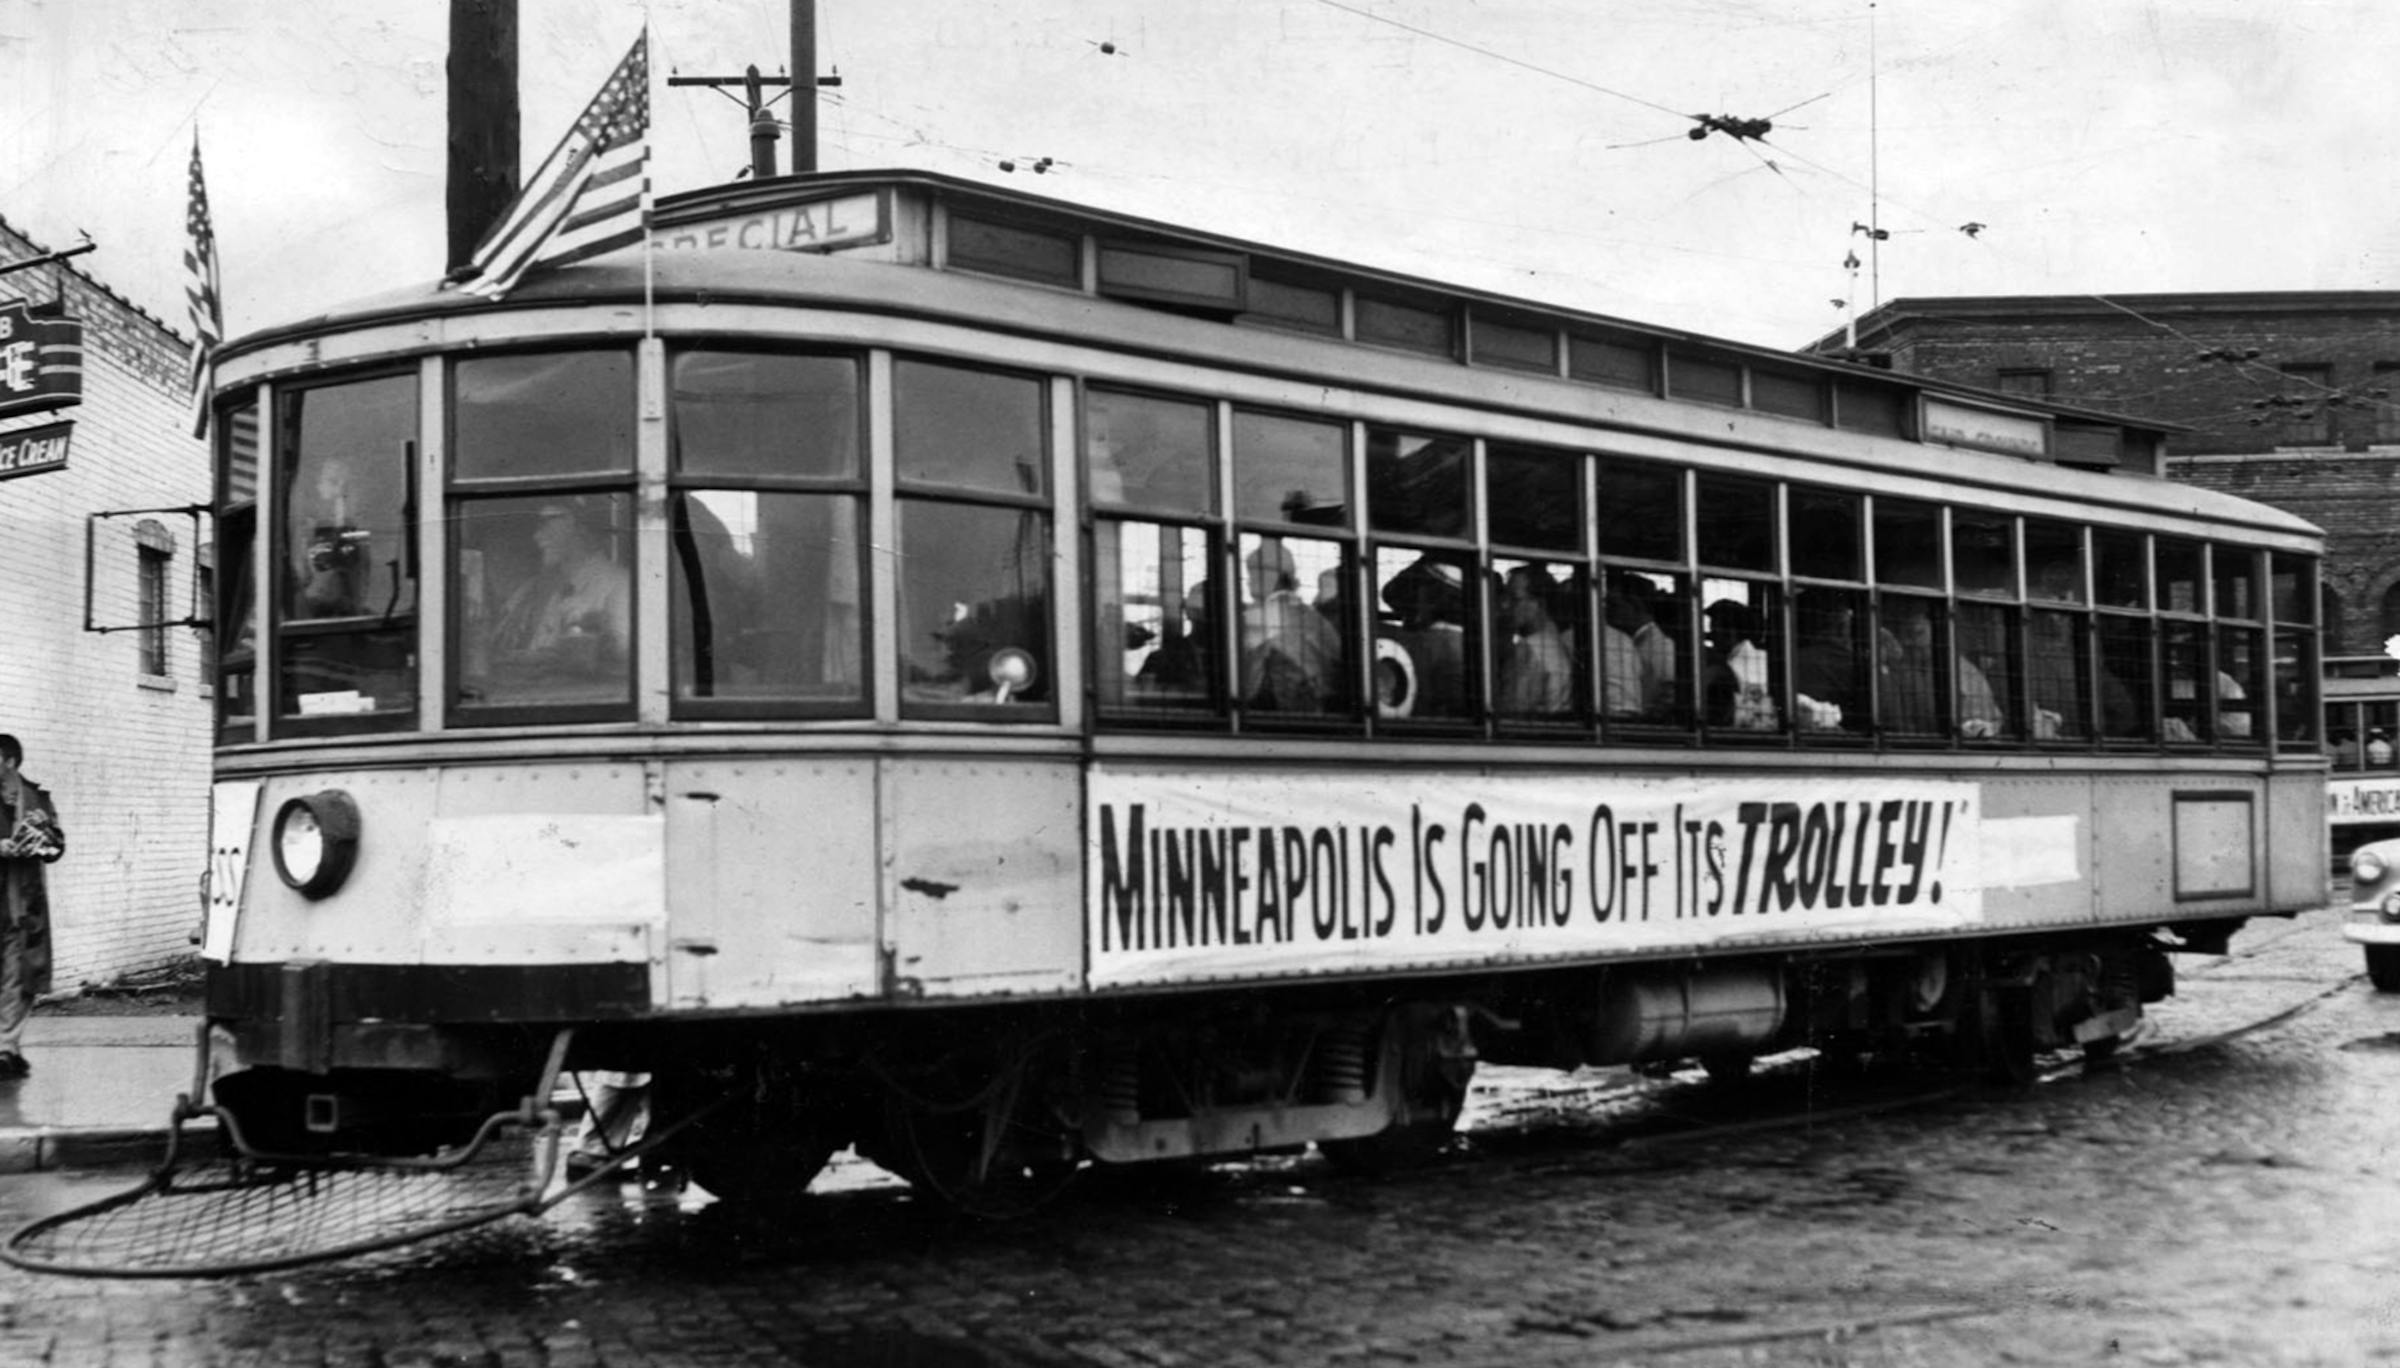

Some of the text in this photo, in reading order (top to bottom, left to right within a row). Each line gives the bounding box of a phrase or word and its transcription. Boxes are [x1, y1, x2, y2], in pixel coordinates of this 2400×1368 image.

[18, 438, 68, 467] CREAM
[1100, 803, 1396, 952] MINNEAPOLIS
[1411, 803, 1446, 935] IS
[1461, 801, 1573, 931] GOING
[1589, 803, 1659, 922] OFF
[1732, 799, 1954, 915] TROLLEY!
